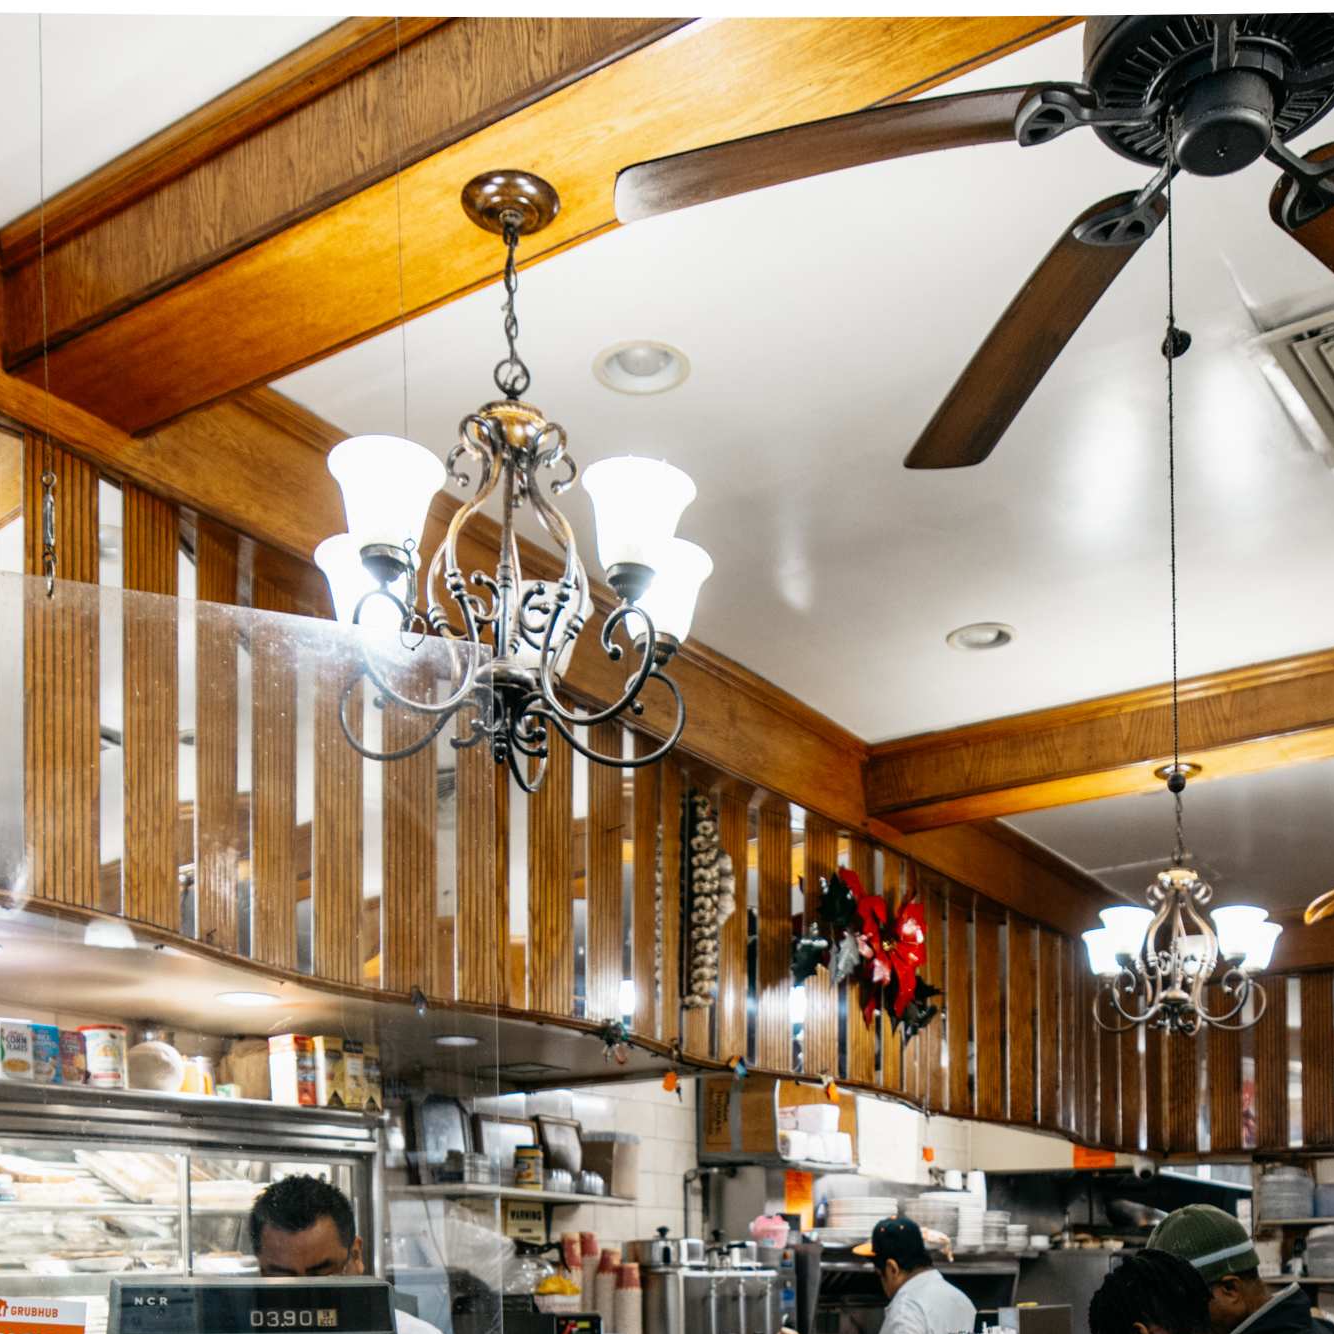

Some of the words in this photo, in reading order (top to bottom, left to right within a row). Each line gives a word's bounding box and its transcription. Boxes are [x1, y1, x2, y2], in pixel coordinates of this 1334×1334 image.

[134, 1296, 168, 1306] NCR
[10, 1306, 59, 1318] GRUBHUB
[250, 1310, 313, 1328] 03.90
